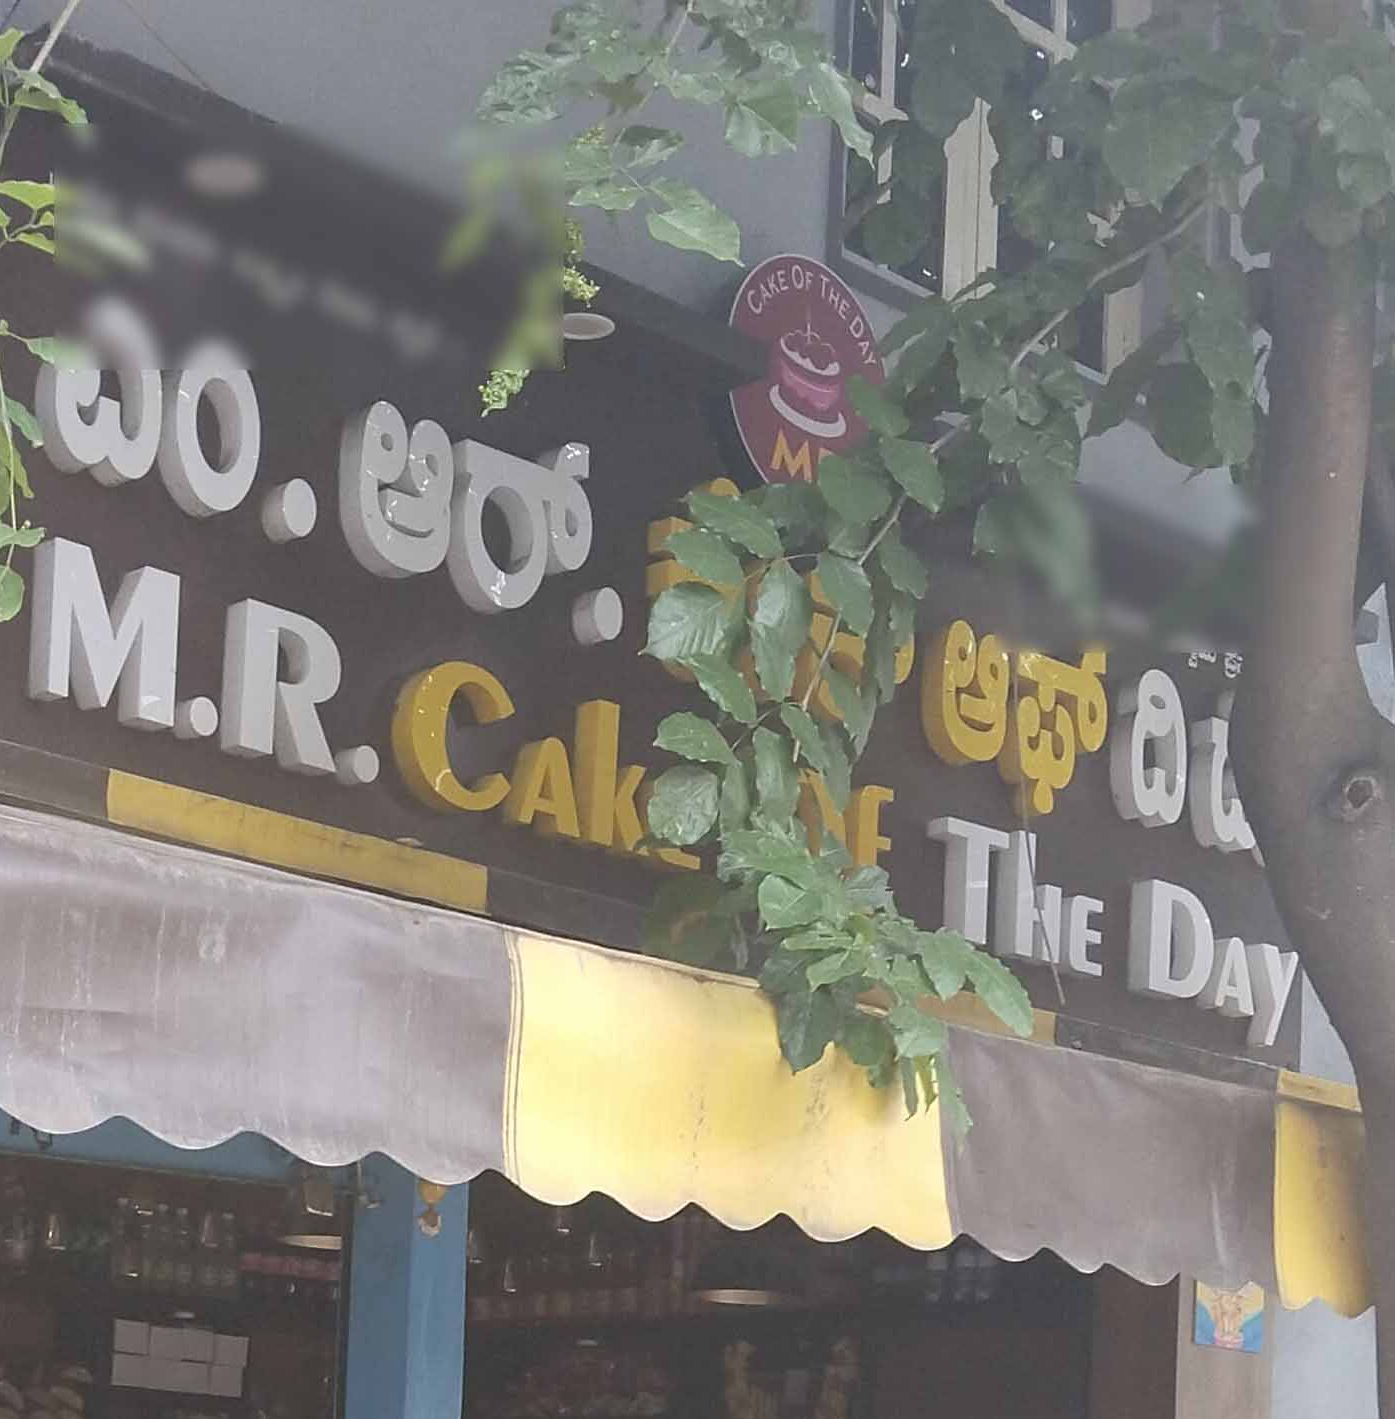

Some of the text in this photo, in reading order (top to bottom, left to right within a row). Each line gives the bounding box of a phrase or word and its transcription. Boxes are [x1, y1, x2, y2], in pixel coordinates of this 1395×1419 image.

[747, 264, 878, 364] CAKE OF THE DAY
[770, 428, 832, 484] M
[29, 538, 380, 785] M.R.
